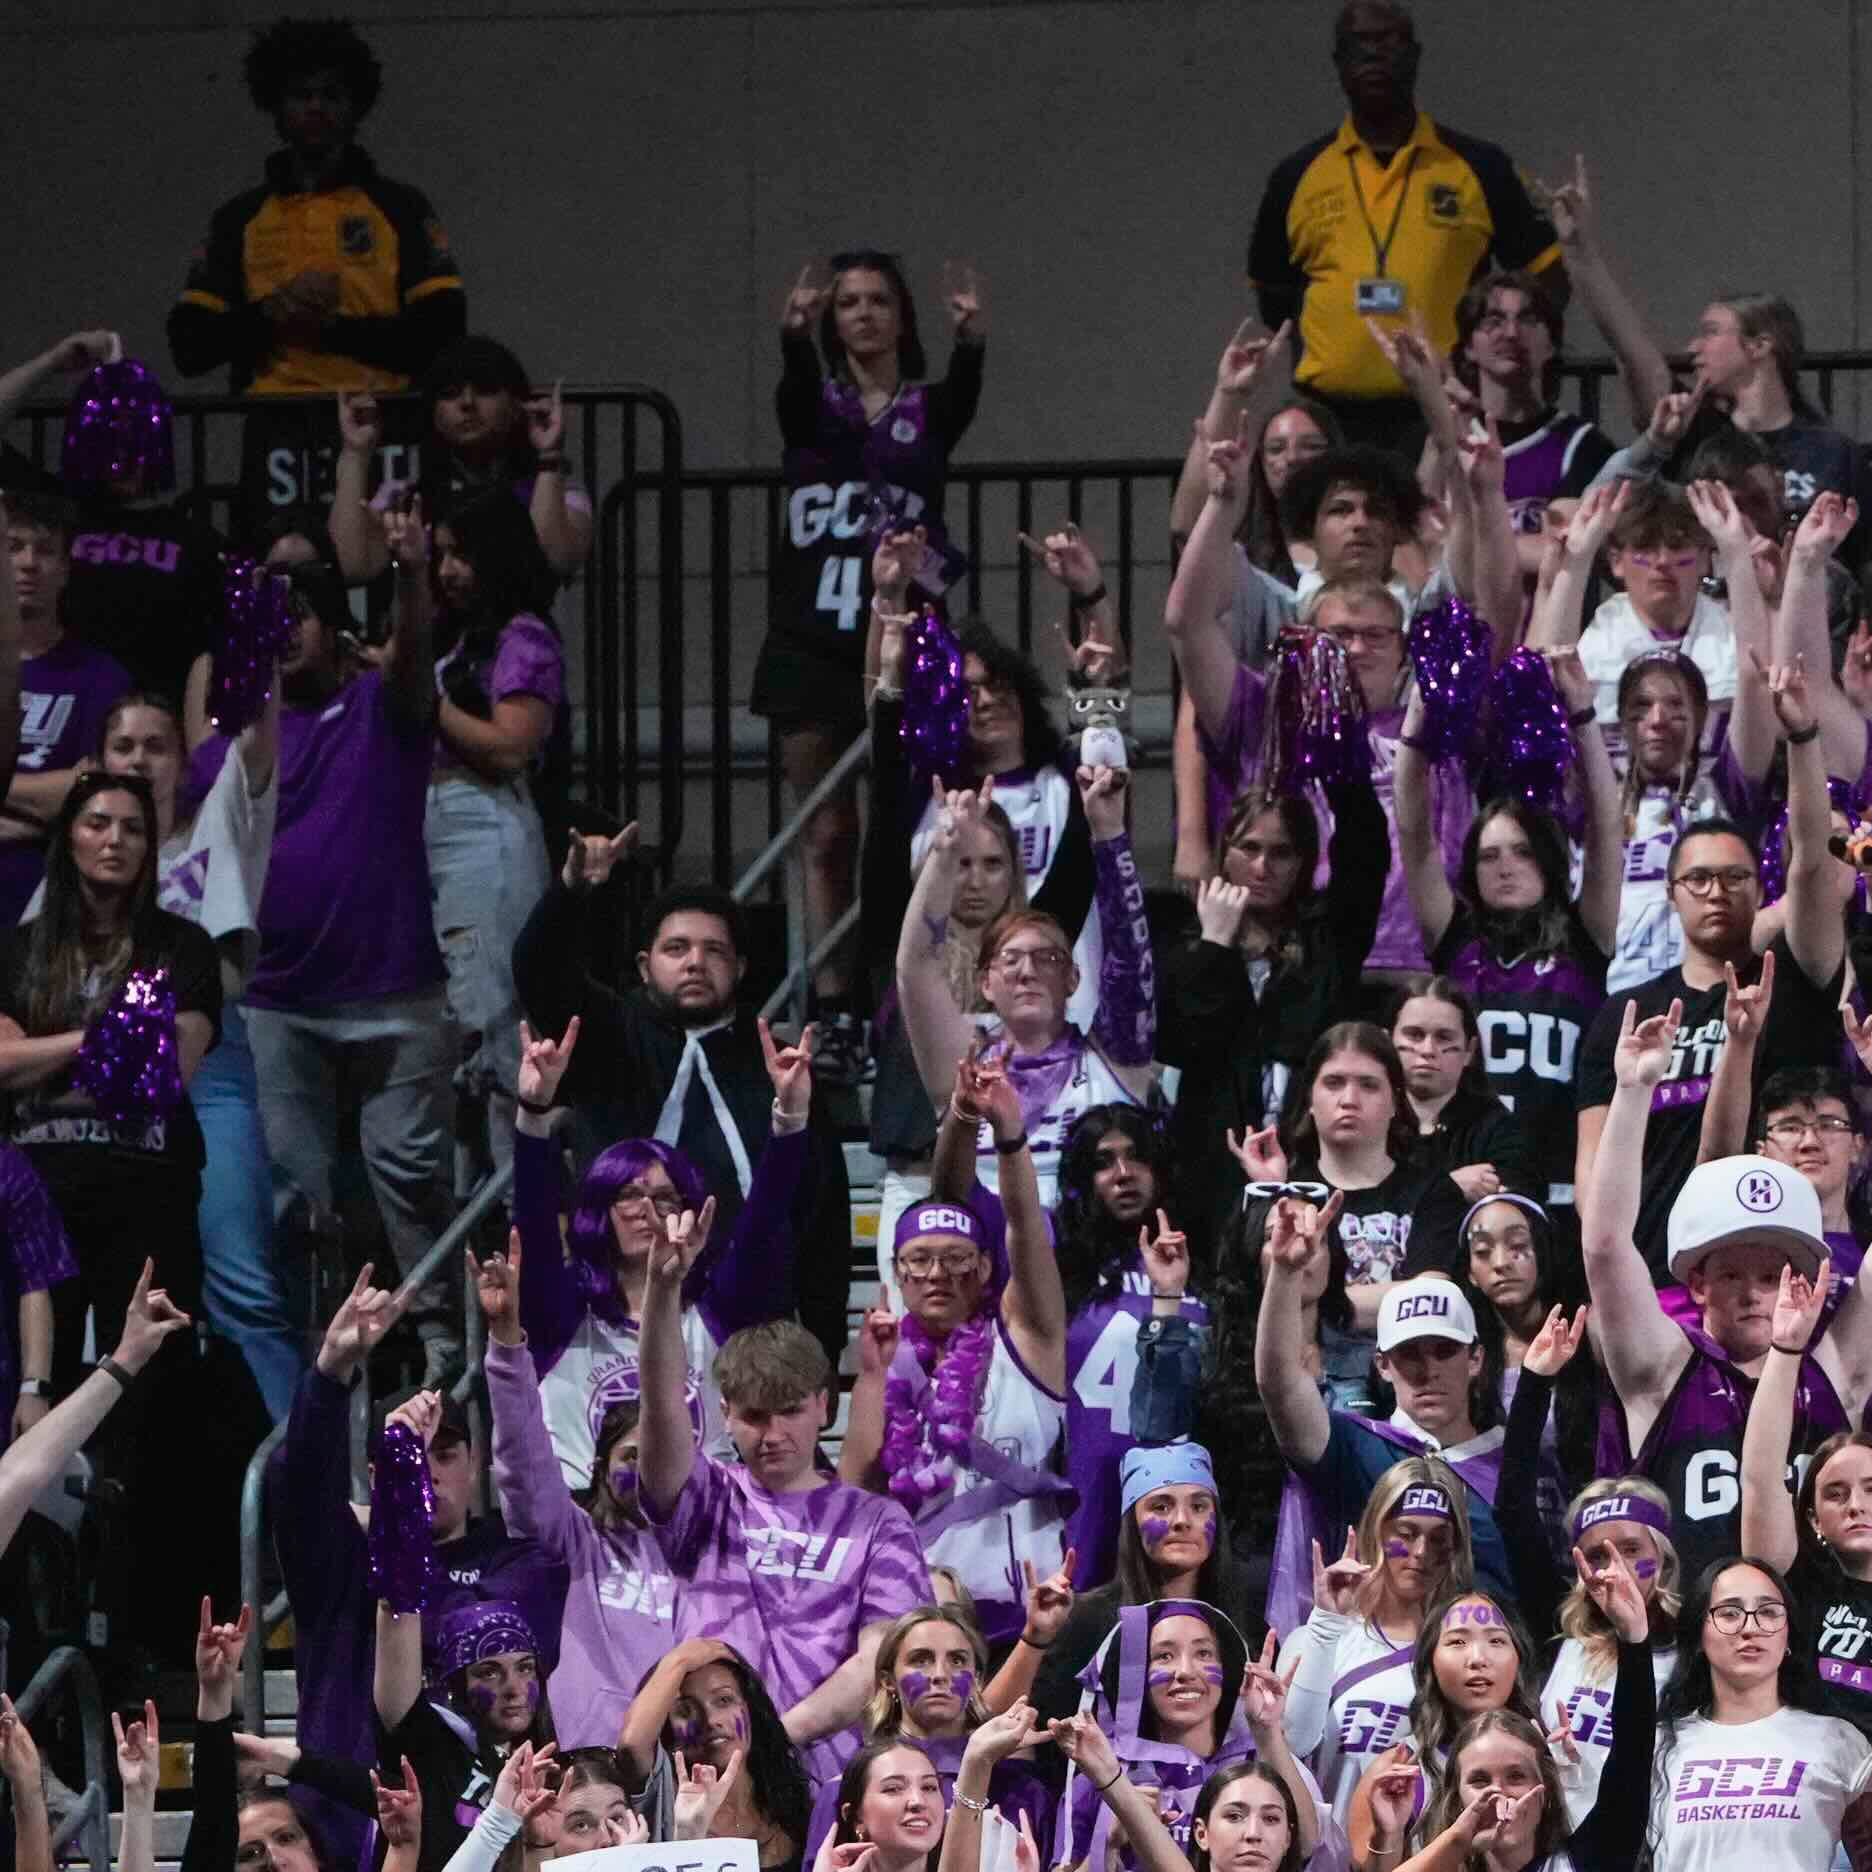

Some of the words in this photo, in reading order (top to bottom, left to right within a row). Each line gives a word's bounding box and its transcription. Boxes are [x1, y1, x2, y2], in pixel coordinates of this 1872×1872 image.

[72, 533, 181, 572] GCU
[810, 555, 864, 630] 4
[1474, 1012, 1577, 1082] CU
[916, 1209, 971, 1233] GCU
[1395, 1296, 1446, 1321] GCU
[1401, 1488, 1448, 1513] GCU
[1580, 1498, 1629, 1528] GCU
[1676, 1758, 1805, 1800] GCU
[1676, 1803, 1800, 1825] BASKETBALL
